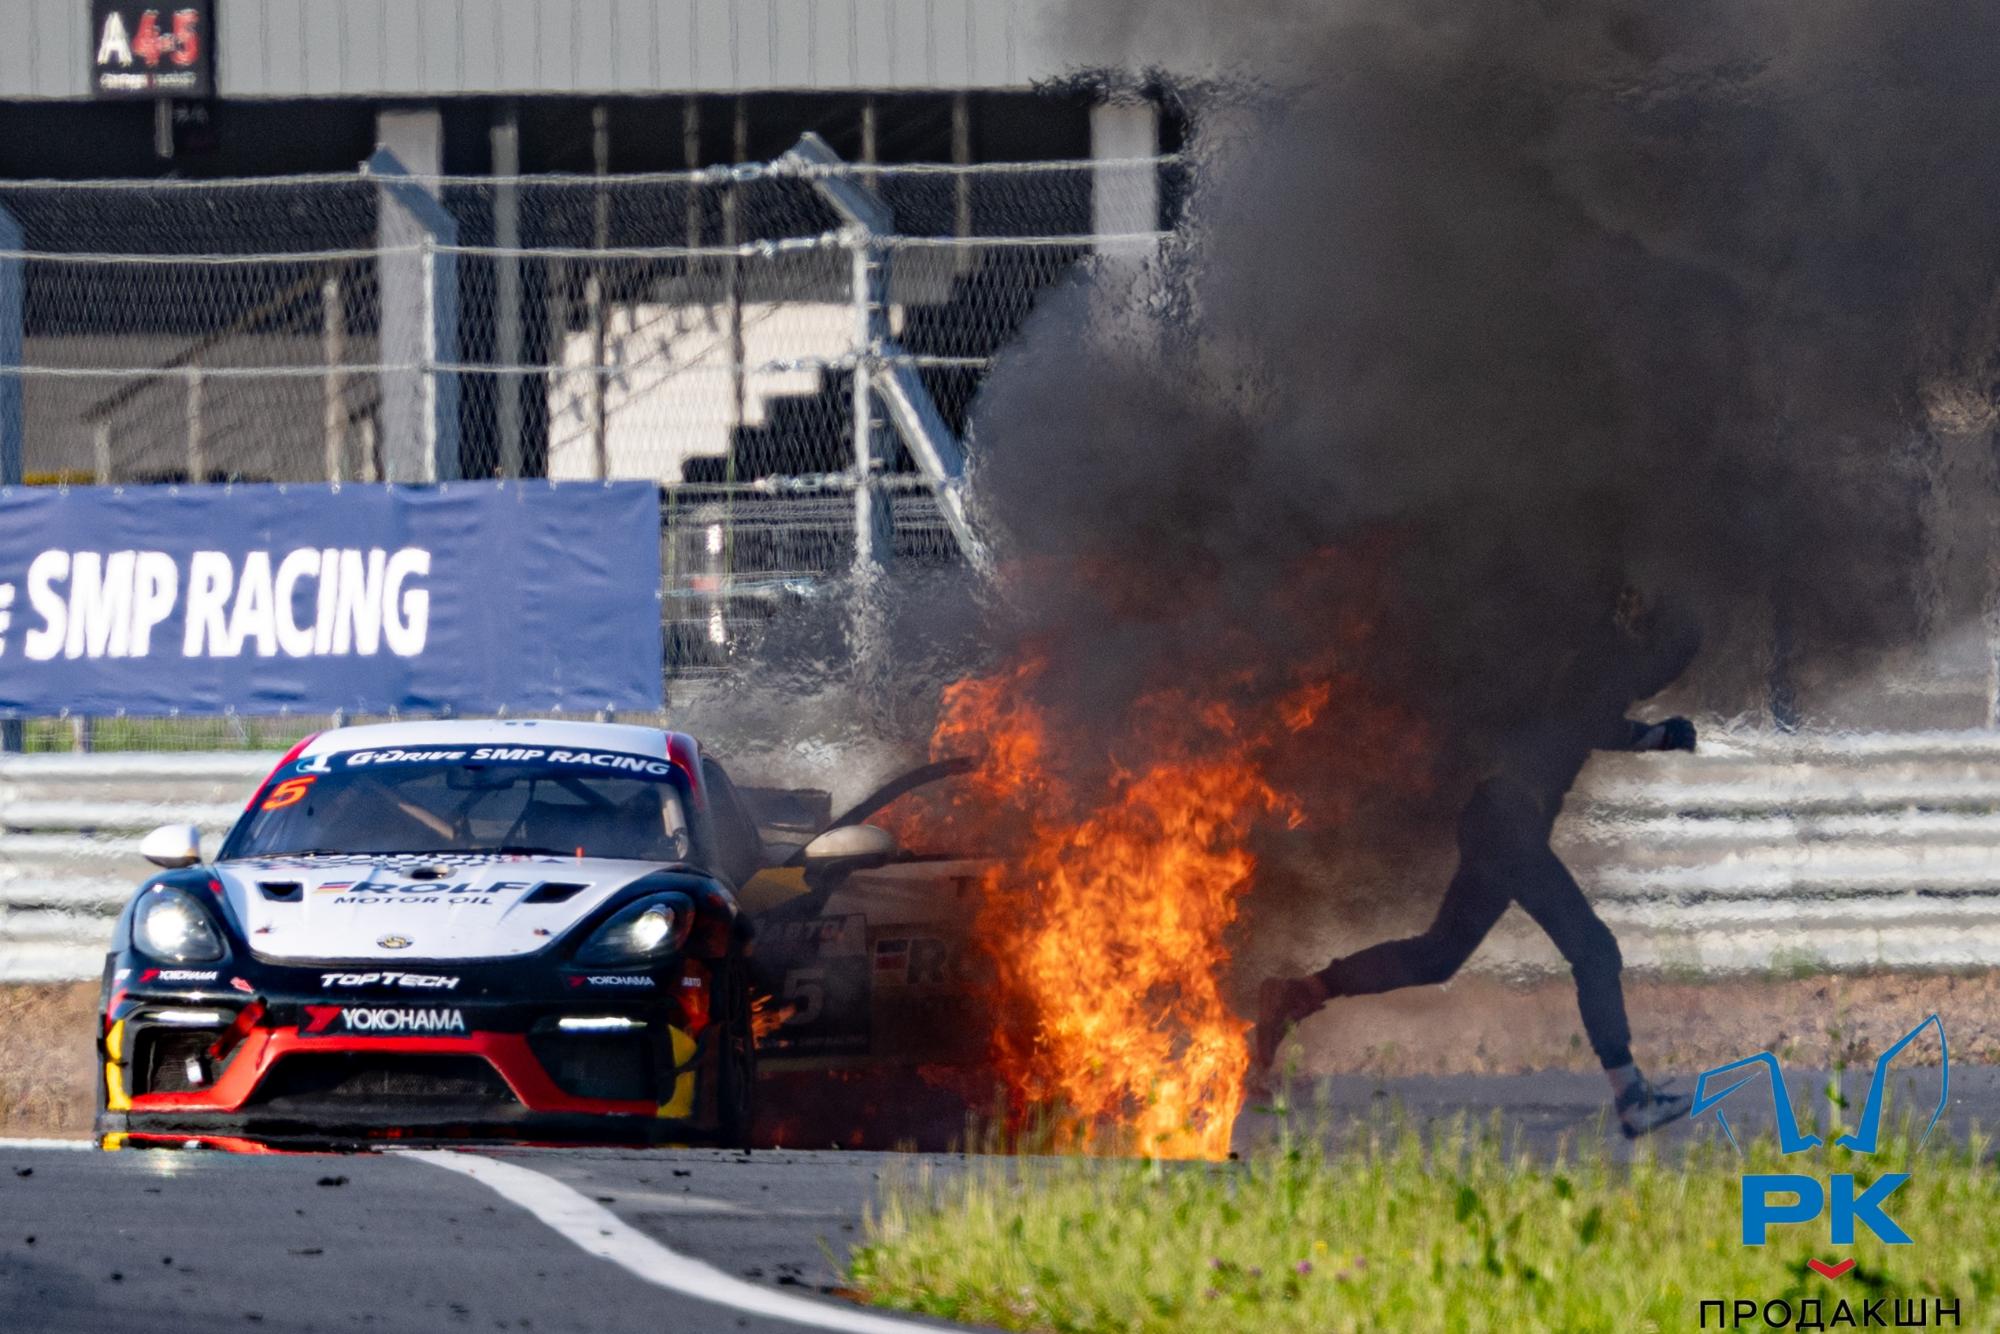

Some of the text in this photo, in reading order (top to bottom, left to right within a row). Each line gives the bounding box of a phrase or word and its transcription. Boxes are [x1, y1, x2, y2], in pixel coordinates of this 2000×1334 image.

[25, 548, 178, 660] SMP
[183, 547, 431, 658] RACING
[471, 748, 545, 761] SMP
[547, 750, 671, 776] RACING
[261, 774, 319, 811] 5
[349, 881, 532, 894] ROLF
[333, 896, 496, 906] MOTOR OIL
[158, 970, 219, 981] YOKOHAMA
[320, 972, 461, 990] TOPTECH
[586, 976, 656, 987] YOKOHAMA
[783, 967, 825, 1025] 5
[341, 1008, 465, 1031] YOKOHAMA
